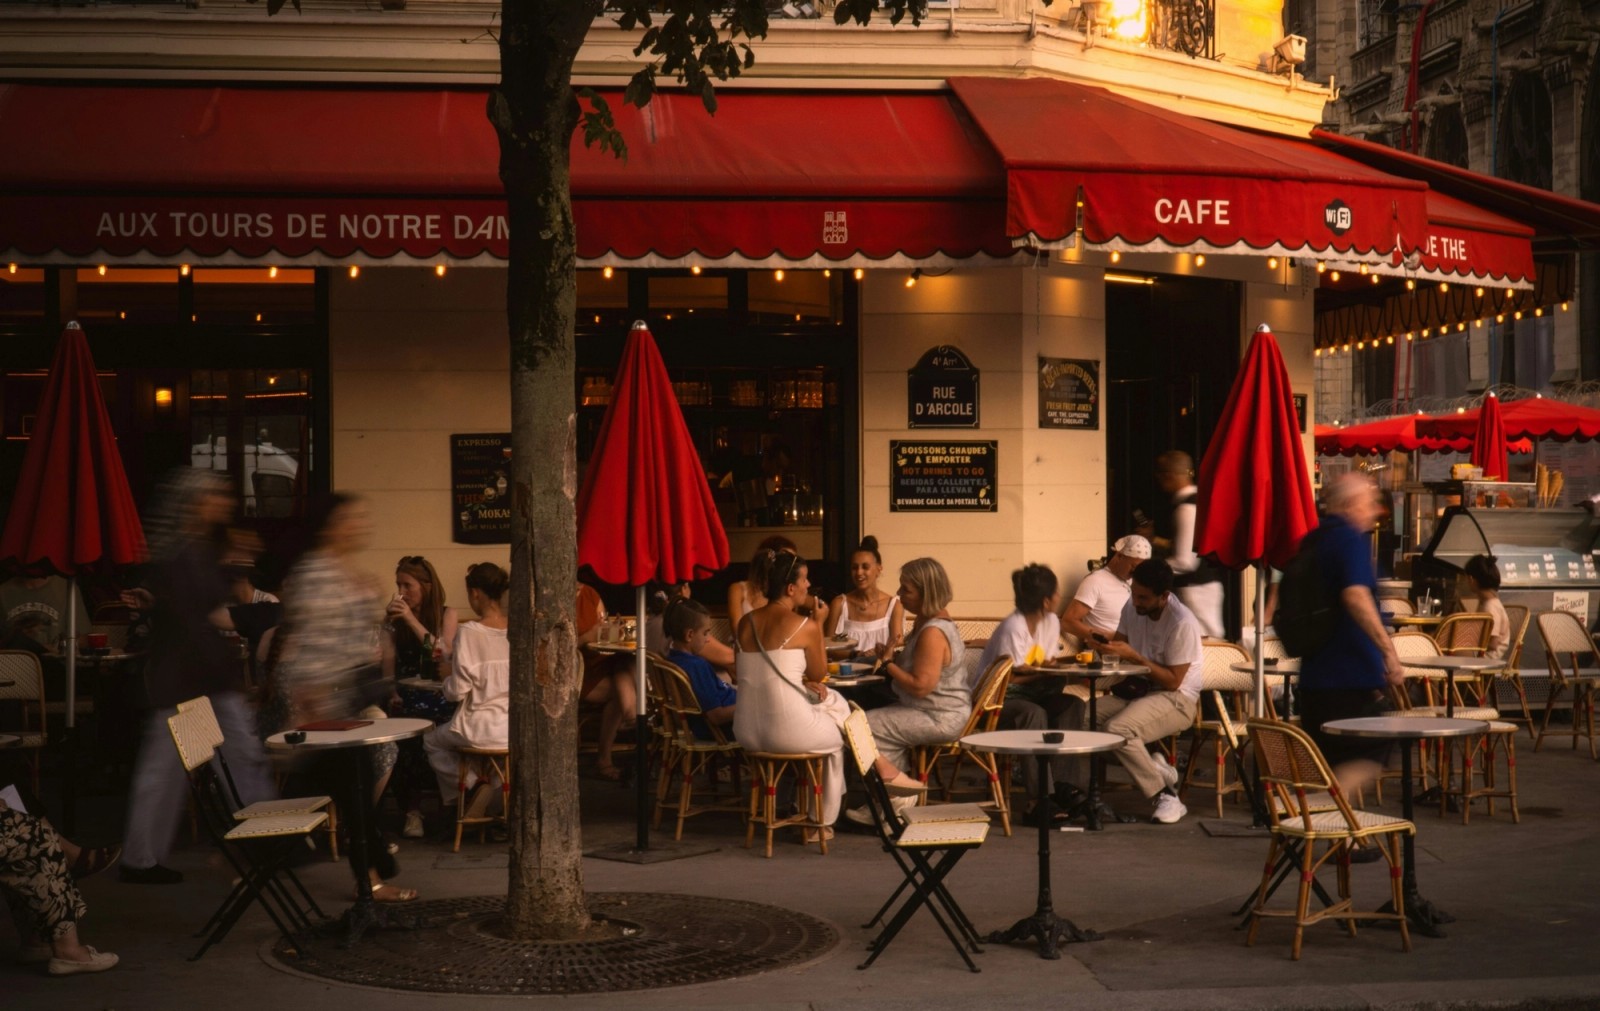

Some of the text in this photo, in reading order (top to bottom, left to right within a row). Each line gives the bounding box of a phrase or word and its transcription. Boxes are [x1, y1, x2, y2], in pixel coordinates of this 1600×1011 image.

[1154, 198, 1230, 225] CAFE
[96, 212, 158, 237] AUX
[169, 212, 274, 238] TOURS
[287, 213, 327, 238] DE
[340, 214, 441, 239] NOTRE
[1440, 236, 1468, 261] THE
[932, 386, 956, 399] RUE
[901, 446, 987, 455] BOISSONS CHAUDES
[914, 455, 971, 464] A EMPORTER
[902, 467, 985, 476] HOT DRINKS TO GO
[916, 486, 973, 494] PARA LLEVAR
[979, 498, 991, 506] VIA
